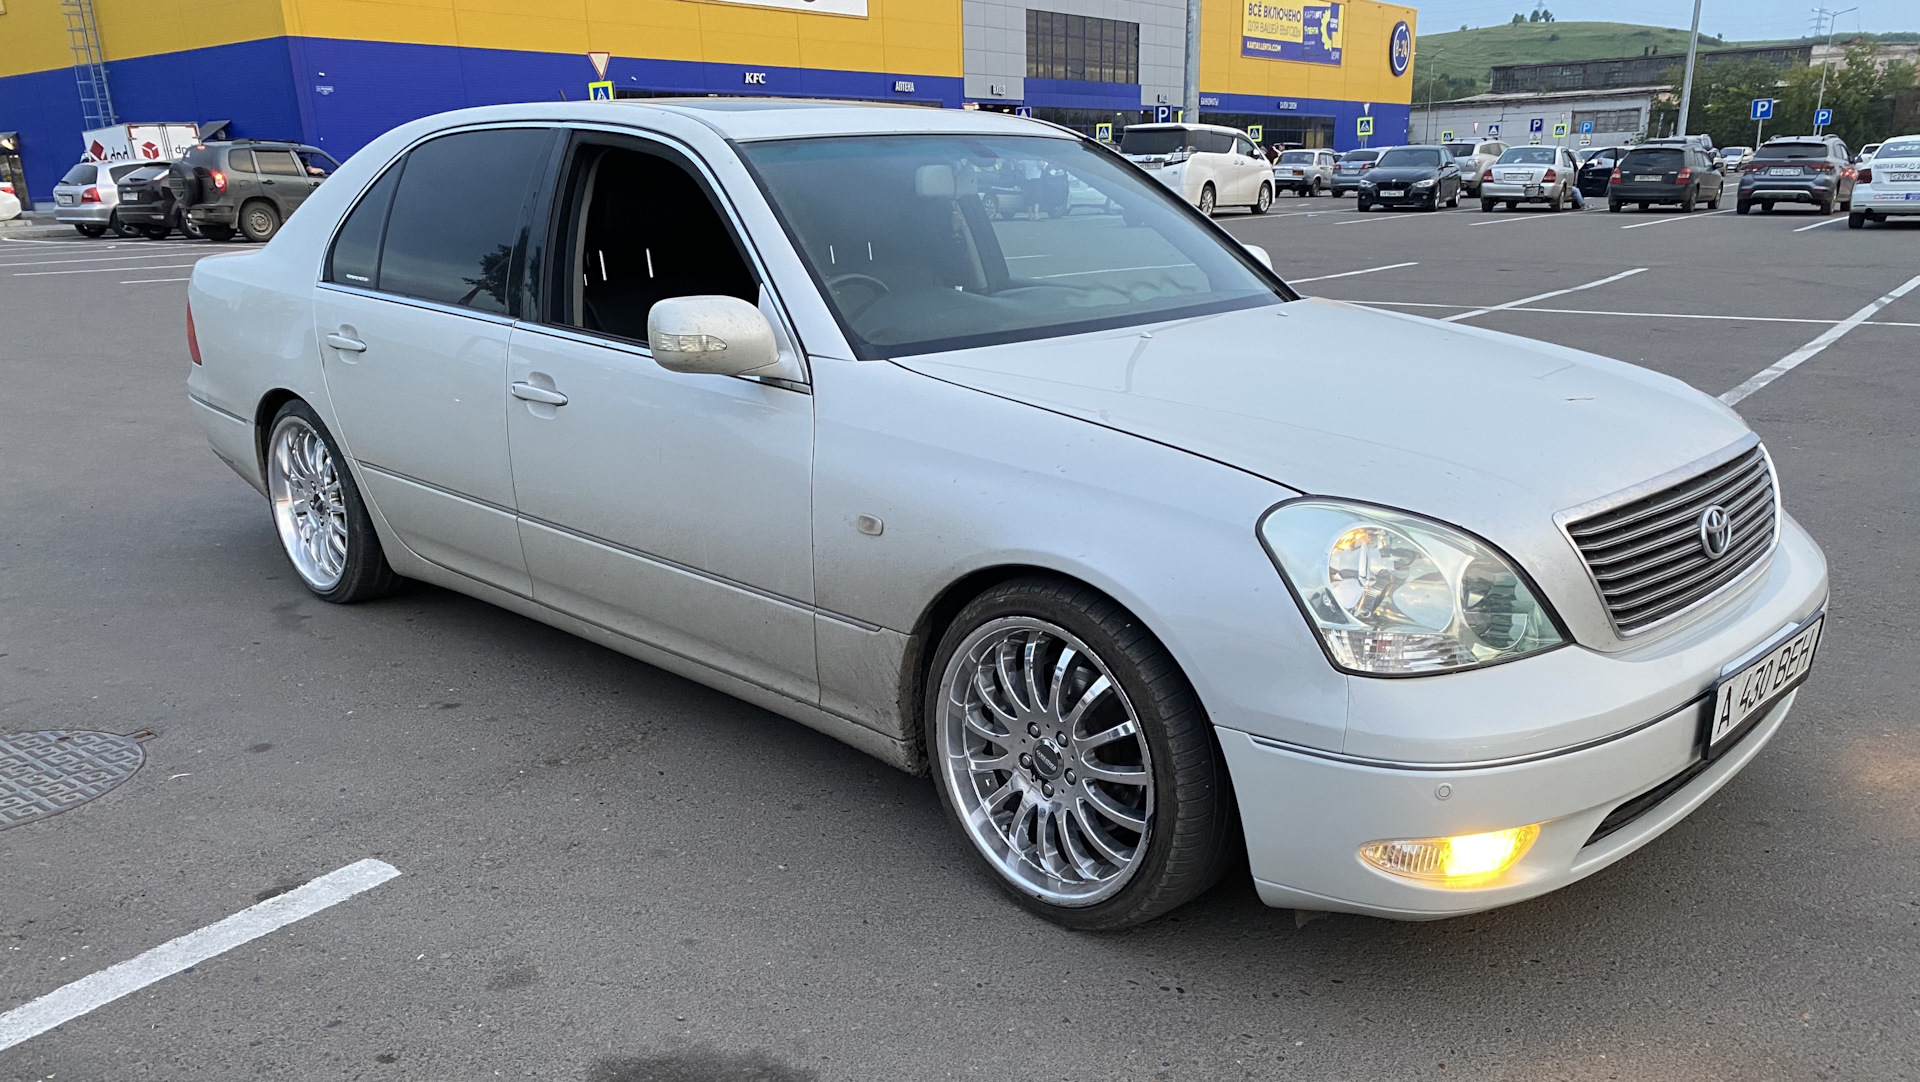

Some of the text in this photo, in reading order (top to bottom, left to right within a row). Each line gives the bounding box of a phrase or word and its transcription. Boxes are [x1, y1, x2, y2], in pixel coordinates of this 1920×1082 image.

[1248, 1, 1302, 23] ВСЁ ВКЛЮЧЕНО
[1247, 20, 1302, 38] ДЛЯ ВАШЕЙ ВЫГОДЫ
[744, 72, 766, 84] KFC
[895, 80, 915, 92] АПТЕКА
[1158, 107, 1169, 123] P
[1757, 101, 1770, 117] P
[1818, 111, 1829, 124] P
[1532, 119, 1541, 132] P
[1582, 122, 1591, 133] P
[110, 144, 129, 159] dpd
[1717, 685, 1732, 735] A
[1739, 658, 1774, 713] 430
